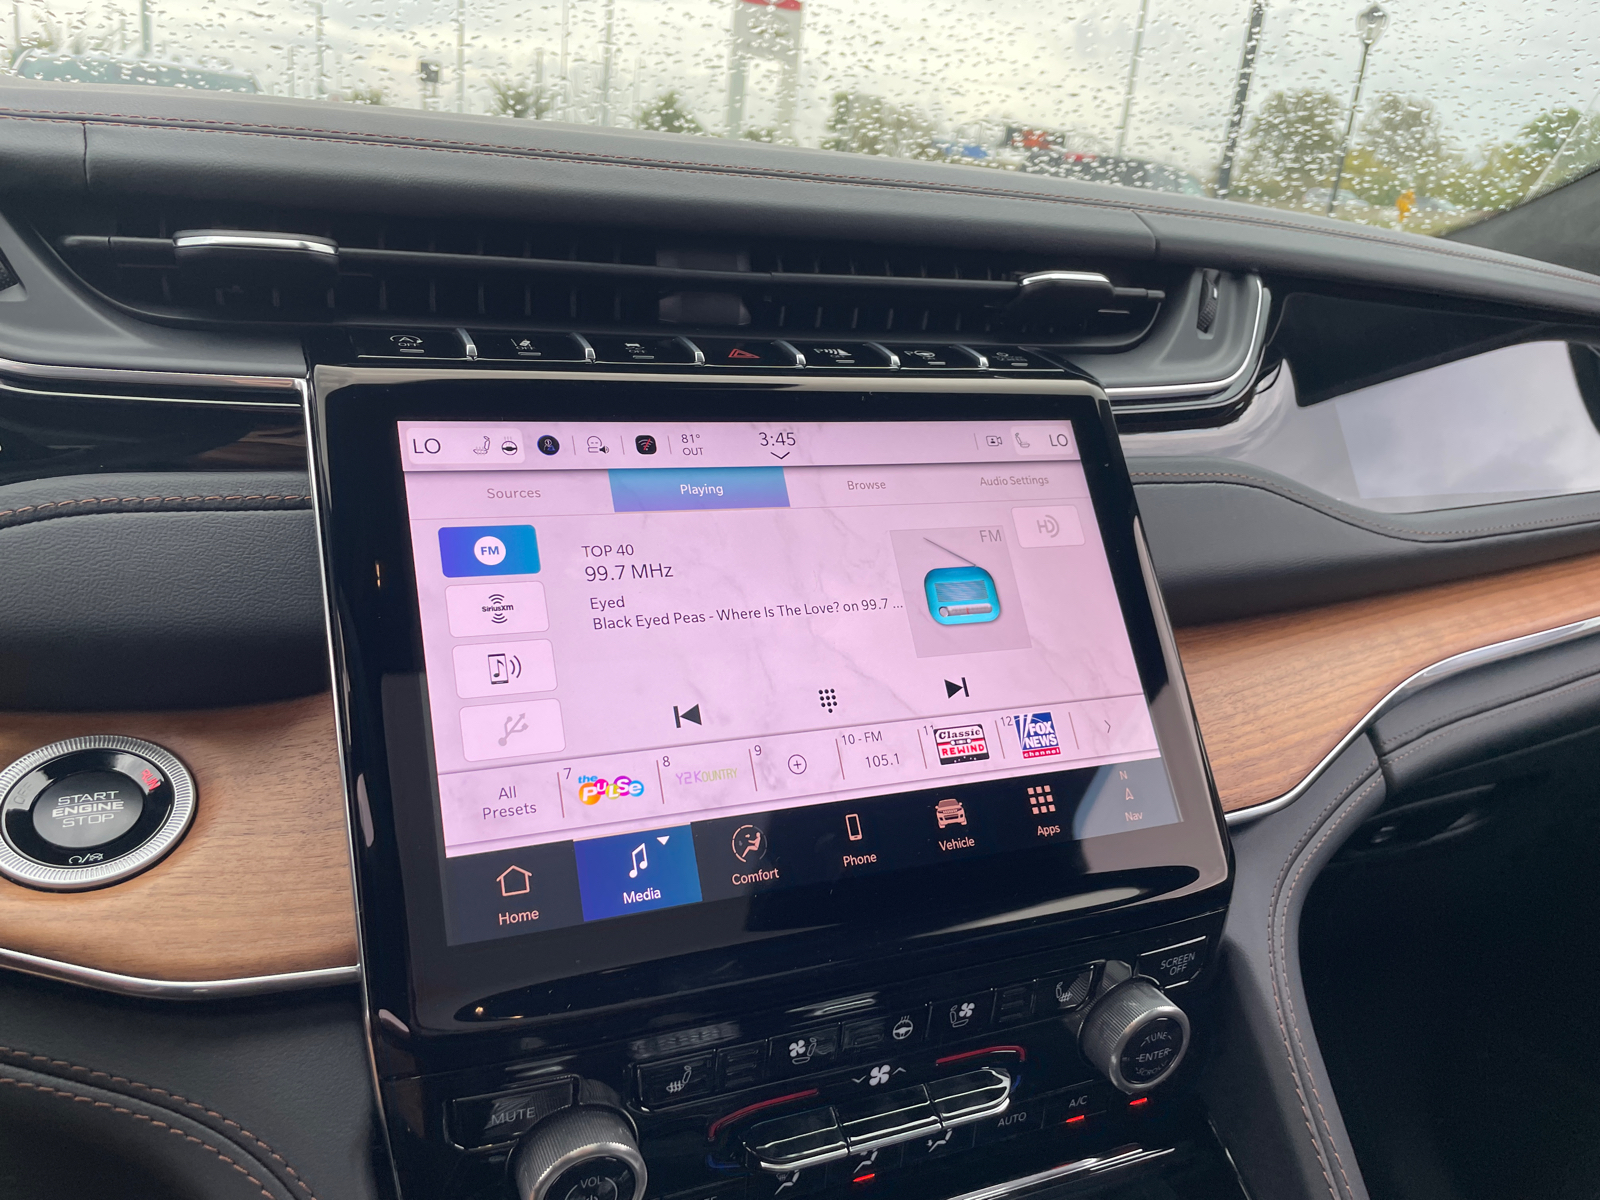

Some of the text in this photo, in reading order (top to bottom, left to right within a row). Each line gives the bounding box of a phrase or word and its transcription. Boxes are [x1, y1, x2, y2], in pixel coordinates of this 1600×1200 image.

[412, 437, 442, 455] LO
[758, 431, 797, 447] 3:45
[1048, 433, 1069, 448] LO
[682, 447, 704, 456] OUT
[846, 480, 887, 491] Browse
[979, 475, 1050, 487] Audio Settings
[486, 487, 541, 500] Sources
[679, 483, 724, 497] Playing
[979, 529, 1002, 544] FM
[480, 545, 500, 556] FM
[581, 543, 635, 558] TOP 40
[584, 562, 674, 582] 99.7 MHz
[589, 595, 626, 612] Eyed
[592, 615, 633, 631] Black
[635, 612, 670, 629] Eyed
[673, 611, 706, 625] Peas
[716, 607, 762, 622] Where
[763, 605, 776, 618] Is
[777, 603, 803, 618] The
[803, 601, 841, 616] Love?
[842, 602, 860, 614] on
[860, 597, 889, 612] 99.7
[1000, 715, 1014, 727] 12
[1028, 720, 1054, 736] FOX
[841, 734, 855, 746] 10
[864, 730, 883, 743] FM
[938, 727, 981, 741] Classic
[1023, 734, 1059, 749] NEWS
[753, 744, 762, 757] 9
[941, 743, 985, 757] REWIND
[1023, 748, 1060, 759] channel
[661, 755, 671, 768] 8
[864, 753, 901, 769] 105.1
[140, 768, 161, 792] RUN
[562, 767, 572, 780] 7
[577, 774, 599, 784] the
[1118, 770, 1129, 781] N
[13, 781, 33, 805] OFF
[57, 790, 120, 807] START
[498, 785, 517, 800] All
[52, 800, 125, 818] ENGINE
[481, 801, 538, 820] Presets
[1124, 810, 1144, 823] Nav
[62, 813, 115, 828] STOP
[1036, 823, 1061, 838] Apps
[937, 835, 976, 852] Vehicle
[842, 851, 878, 868] Phone
[731, 867, 780, 886] Comfort
[622, 887, 662, 905] Media
[498, 907, 540, 926] Home
[1160, 951, 1196, 971] SCREEN
[1169, 962, 1188, 976] OFF
[1144, 1031, 1169, 1044] TUNE
[1138, 1047, 1170, 1063] ENTER
[1068, 1094, 1088, 1109] A/C
[490, 1106, 537, 1127] MUTE
[996, 1111, 1028, 1128] AUTO
[580, 1175, 602, 1189] VOL
